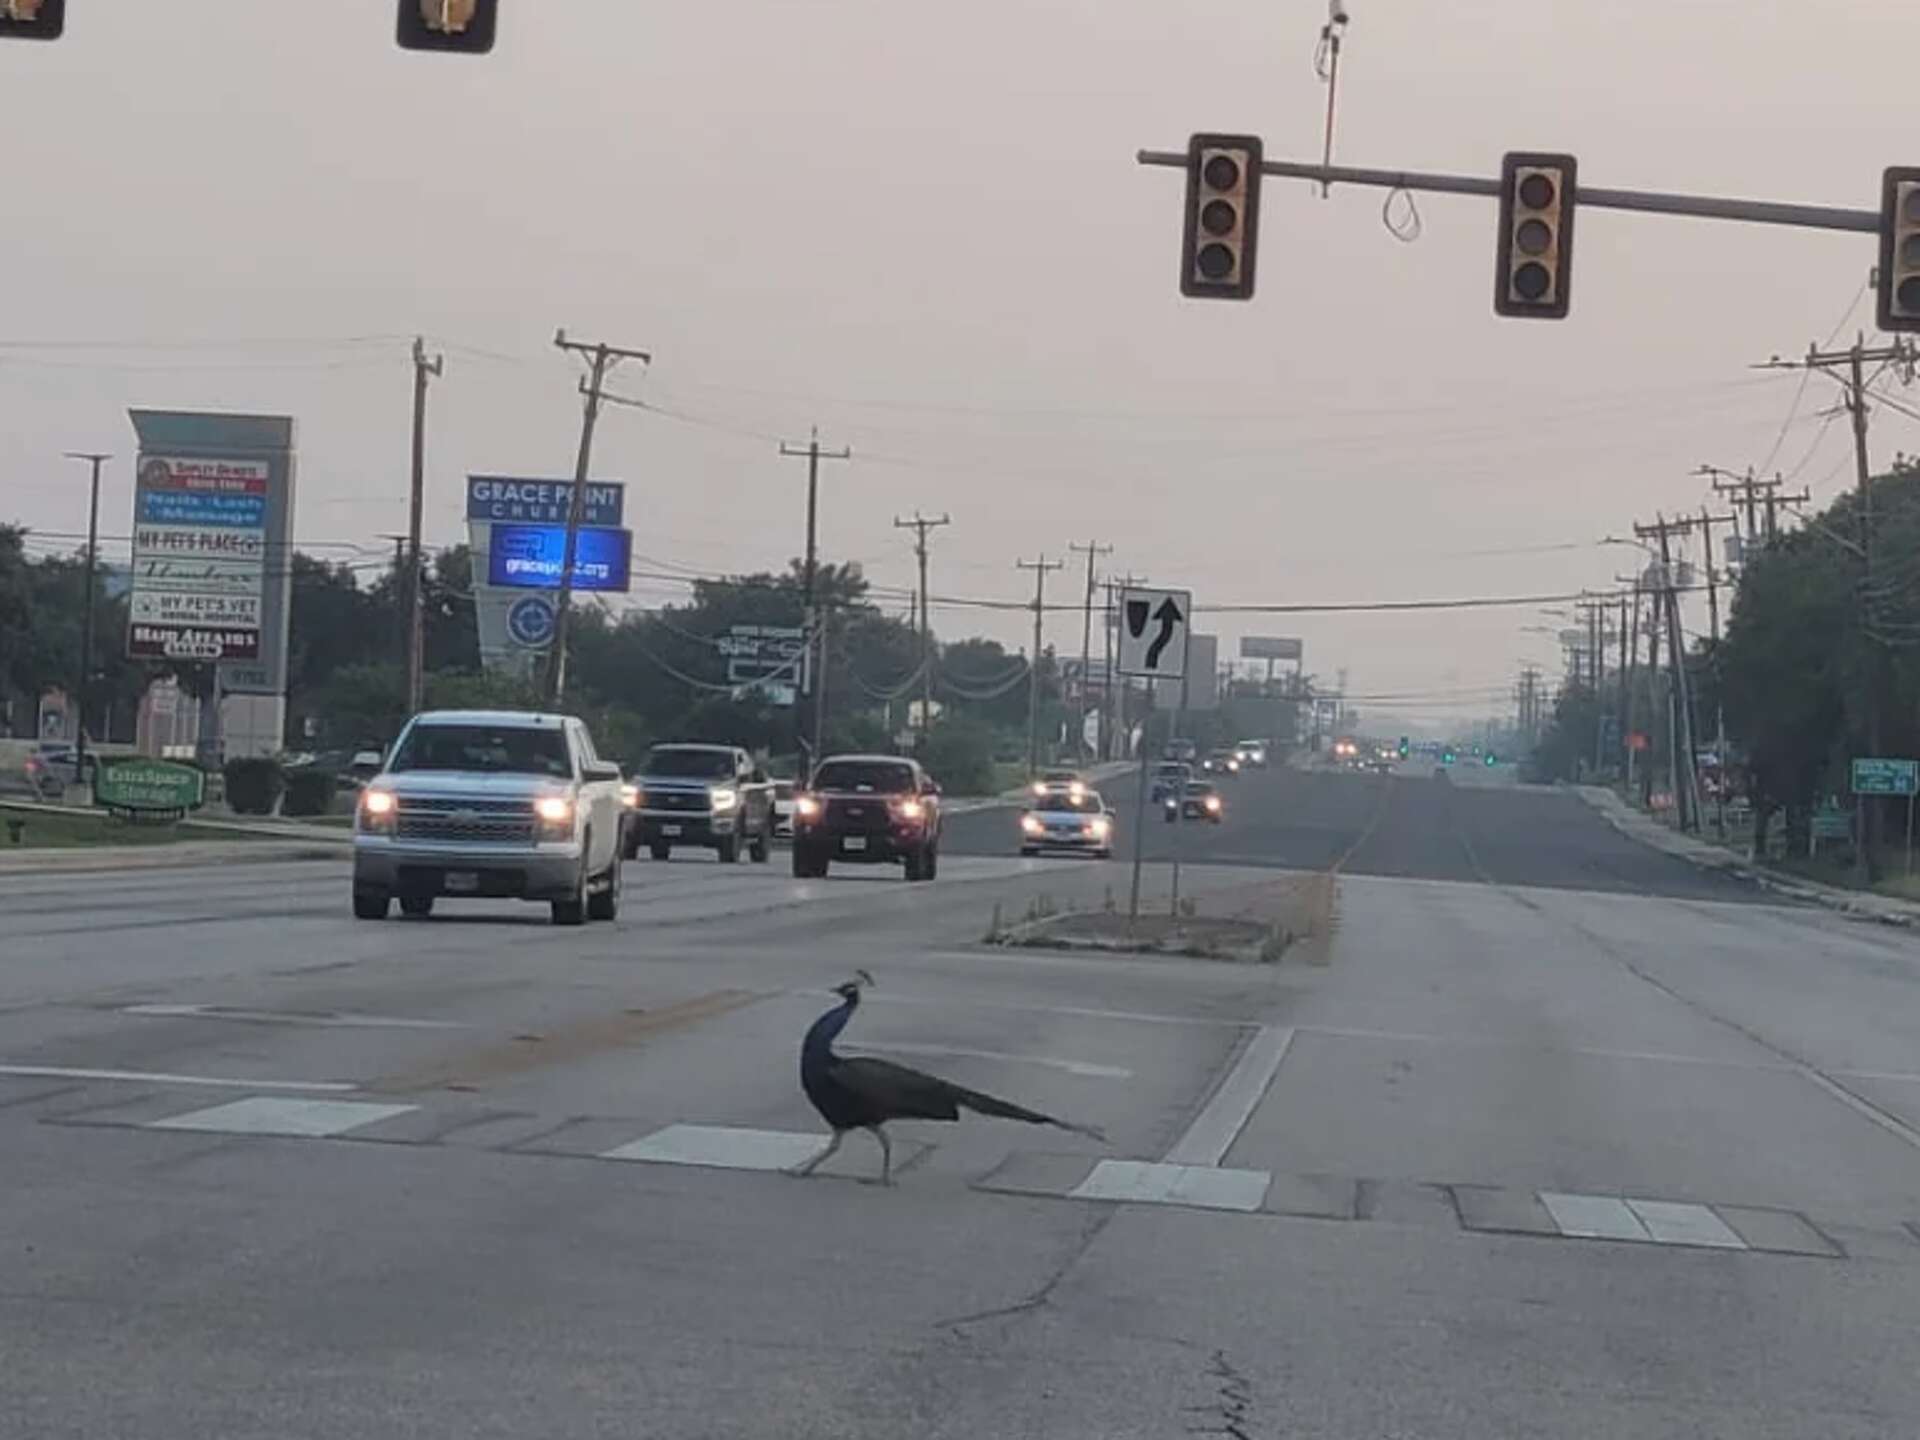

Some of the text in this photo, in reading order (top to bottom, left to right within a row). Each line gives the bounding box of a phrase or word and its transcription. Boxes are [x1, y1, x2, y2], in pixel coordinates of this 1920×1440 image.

[472, 481, 549, 503] GRACE
[506, 558, 609, 579] gracepot.org
[161, 596, 257, 613] MY PET'S VET
